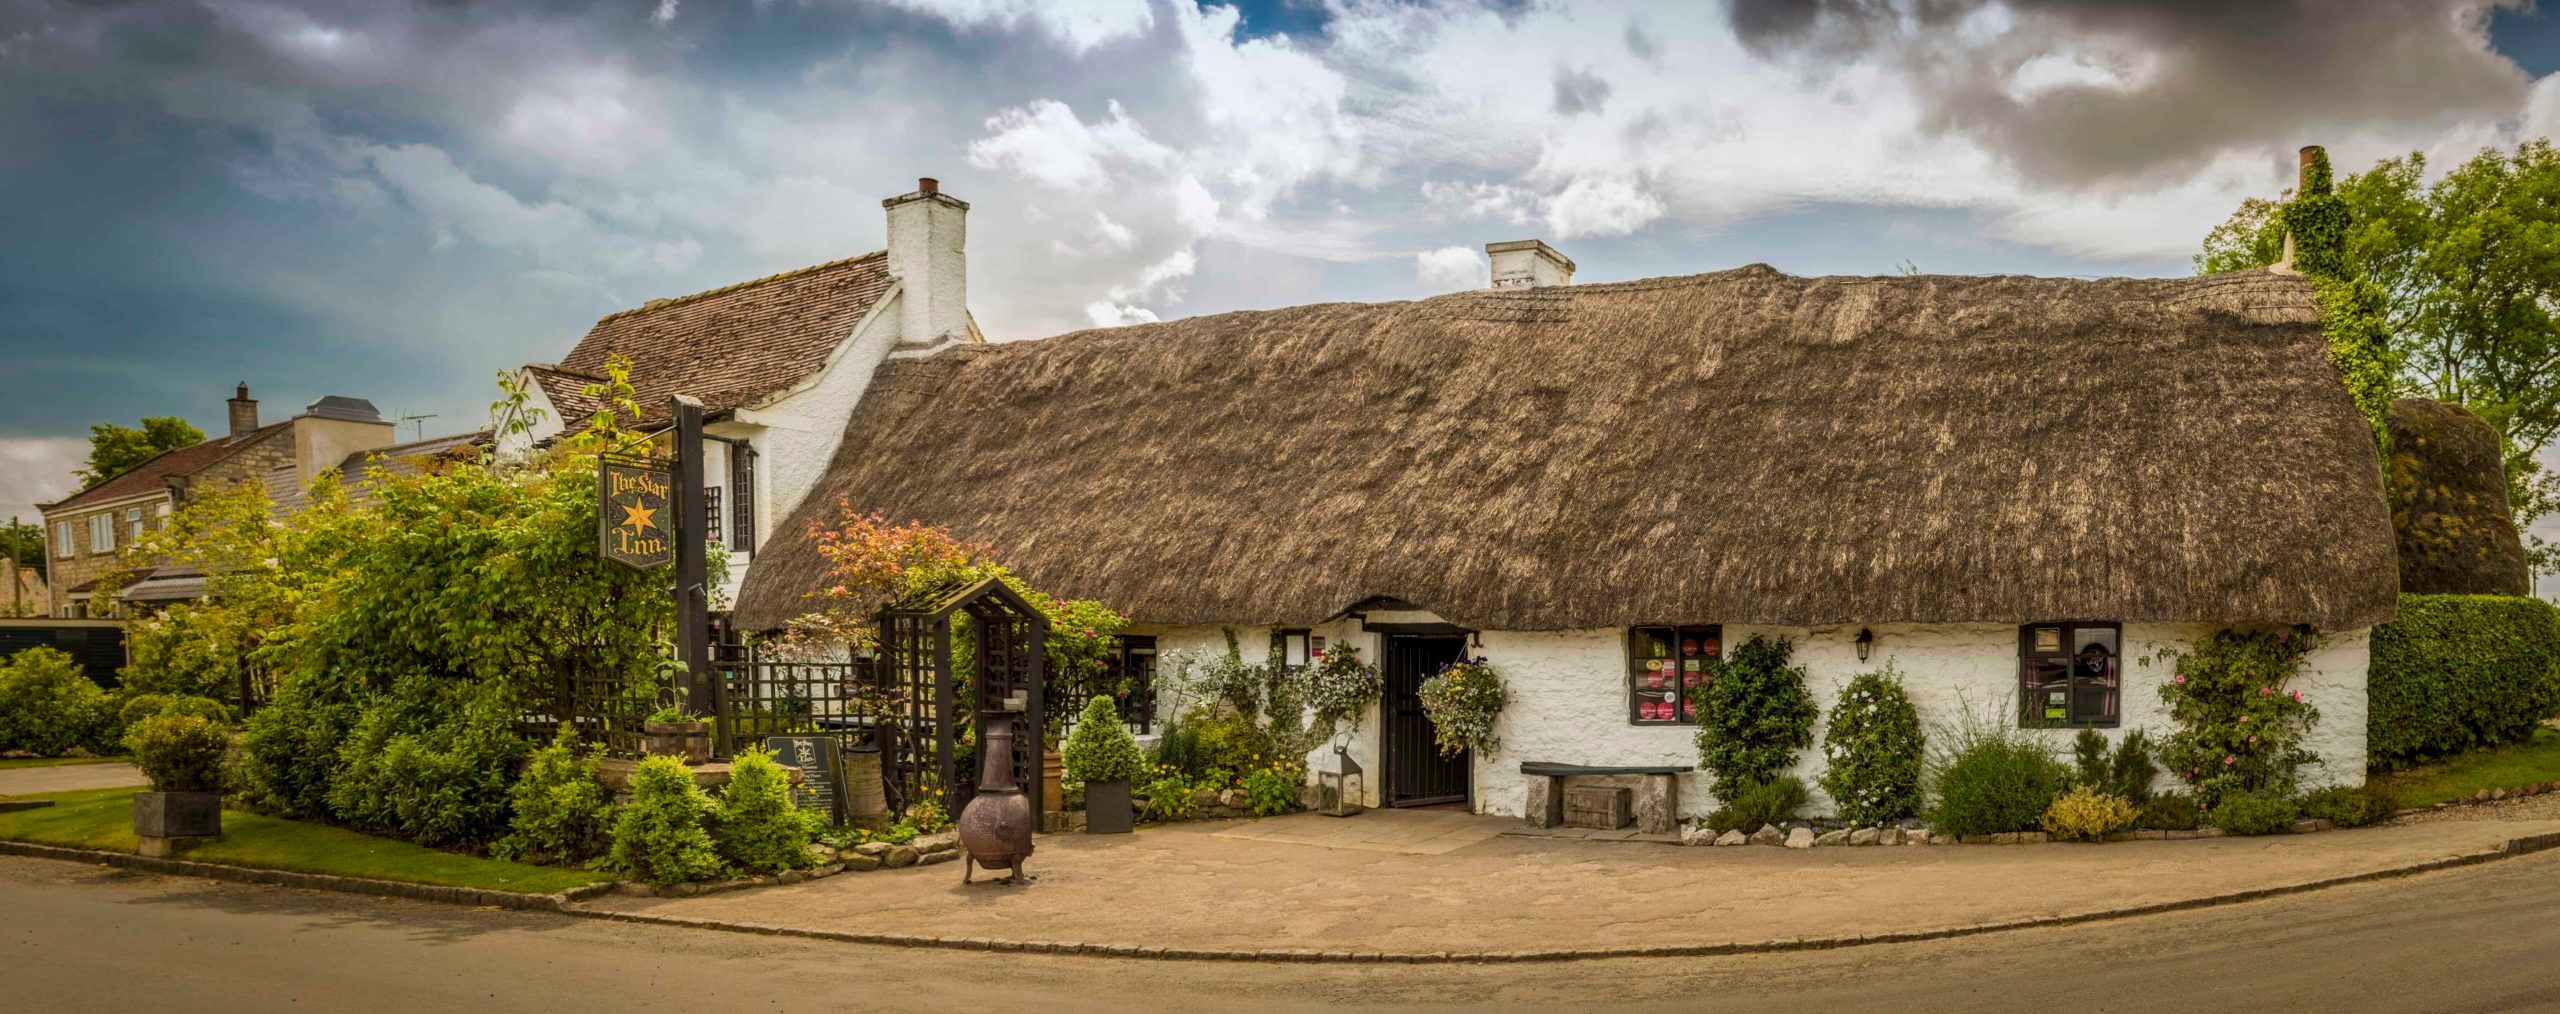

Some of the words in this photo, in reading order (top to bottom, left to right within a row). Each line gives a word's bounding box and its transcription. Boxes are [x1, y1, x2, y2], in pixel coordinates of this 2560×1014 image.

[610, 471, 636, 498] The
[632, 472, 669, 500] Star
[612, 528, 667, 555] Inn
